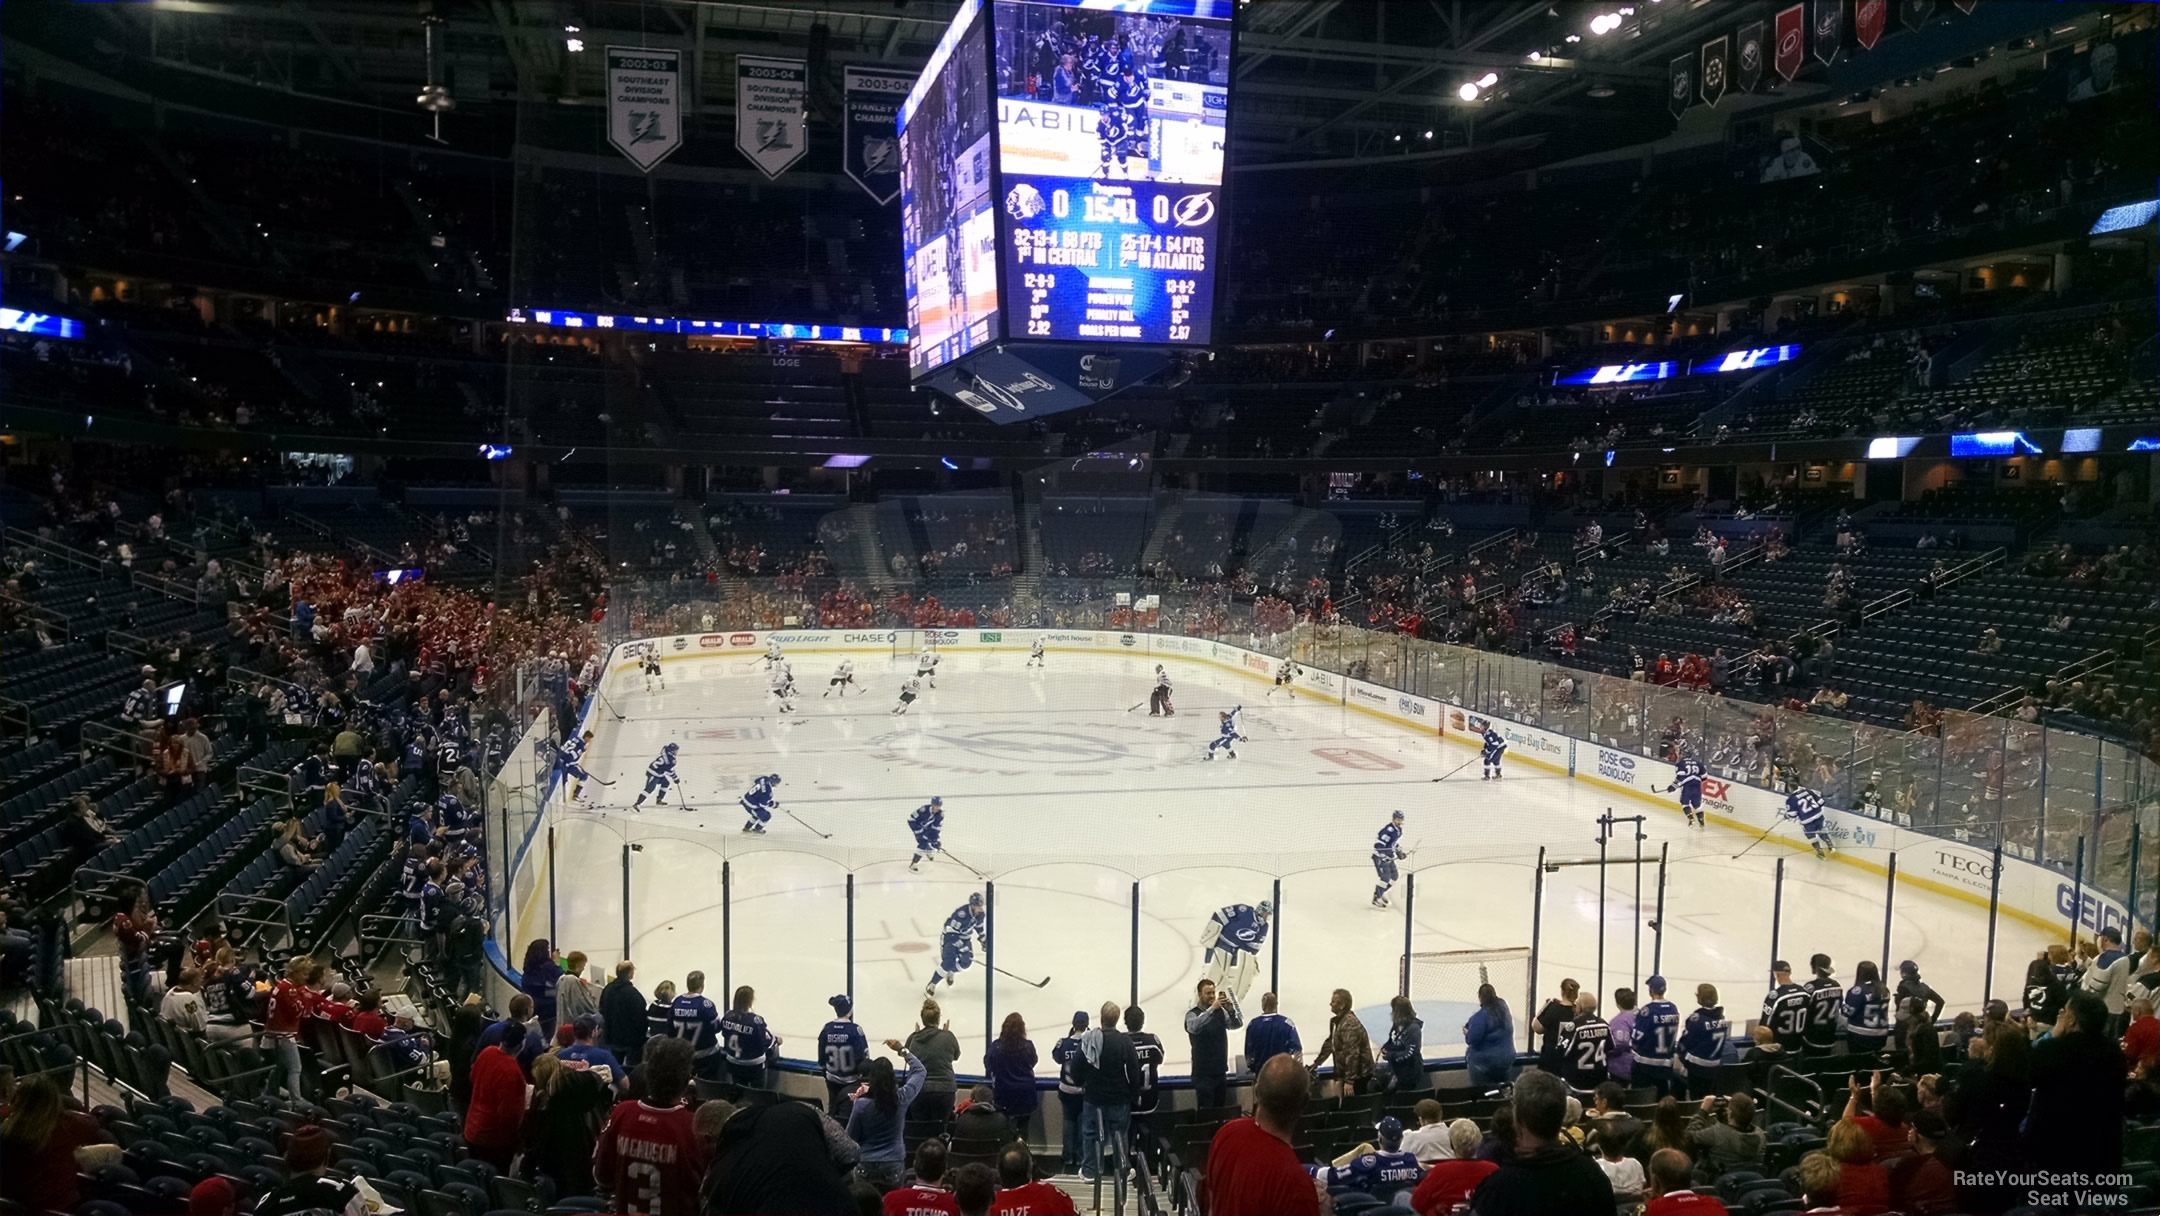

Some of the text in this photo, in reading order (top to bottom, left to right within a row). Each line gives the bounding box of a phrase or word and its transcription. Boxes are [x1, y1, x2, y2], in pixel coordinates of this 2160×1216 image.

[619, 58, 668, 70] 2002-03
[617, 76, 670, 85] SOUTHEAST
[749, 67, 795, 79] 2003-04
[624, 87, 663, 95] DIVISION
[857, 79, 910, 90] 2003-04
[617, 95, 671, 105] CHAMPIONS
[753, 94, 790, 103] DIVISION
[747, 103, 797, 113] CHAMPIONS
[850, 103, 893, 112] STANLEY
[1053, 189, 1069, 218] 0
[1083, 195, 1138, 224] 15:41
[1153, 194, 1169, 223] 0
[1183, 236, 1204, 254] PTS
[1033, 247, 1047, 264] IN
[1048, 248, 1099, 267] CENTRAL
[1138, 251, 1151, 269] IN
[1152, 253, 1205, 271] ATLANTIC
[773, 358, 800, 367] LOGE
[797, 634, 832, 643] LIGHT
[844, 633, 885, 643] CHASE
[1048, 633, 1093, 643] bright house
[1310, 671, 1334, 687] JABIL
[1412, 702, 1426, 716] SUN
[1505, 728, 1527, 747] Tampa
[1527, 733, 1541, 751] Bay
[1541, 737, 1562, 755] Times
[1599, 749, 1619, 767] ROSE
[1598, 763, 1636, 785] RADIOLOGY
[1701, 797, 1735, 813] maging
[1931, 868, 2003, 895] TAMPA ELECTRC
[674, 1008, 698, 1017] HEDMAN
[1814, 999, 1840, 1024] 24
[1778, 1008, 1807, 1034] 30
[728, 1034, 742, 1058] 4
[827, 1034, 849, 1043] BISHOP
[1655, 1026, 1679, 1053] 17
[409, 1049, 421, 1062] 91
[825, 1045, 856, 1071] 30
[1577, 1040, 1608, 1070] 24
[1380, 1168, 1418, 1182] STAMKOS
[627, 1162, 661, 1215] 3
